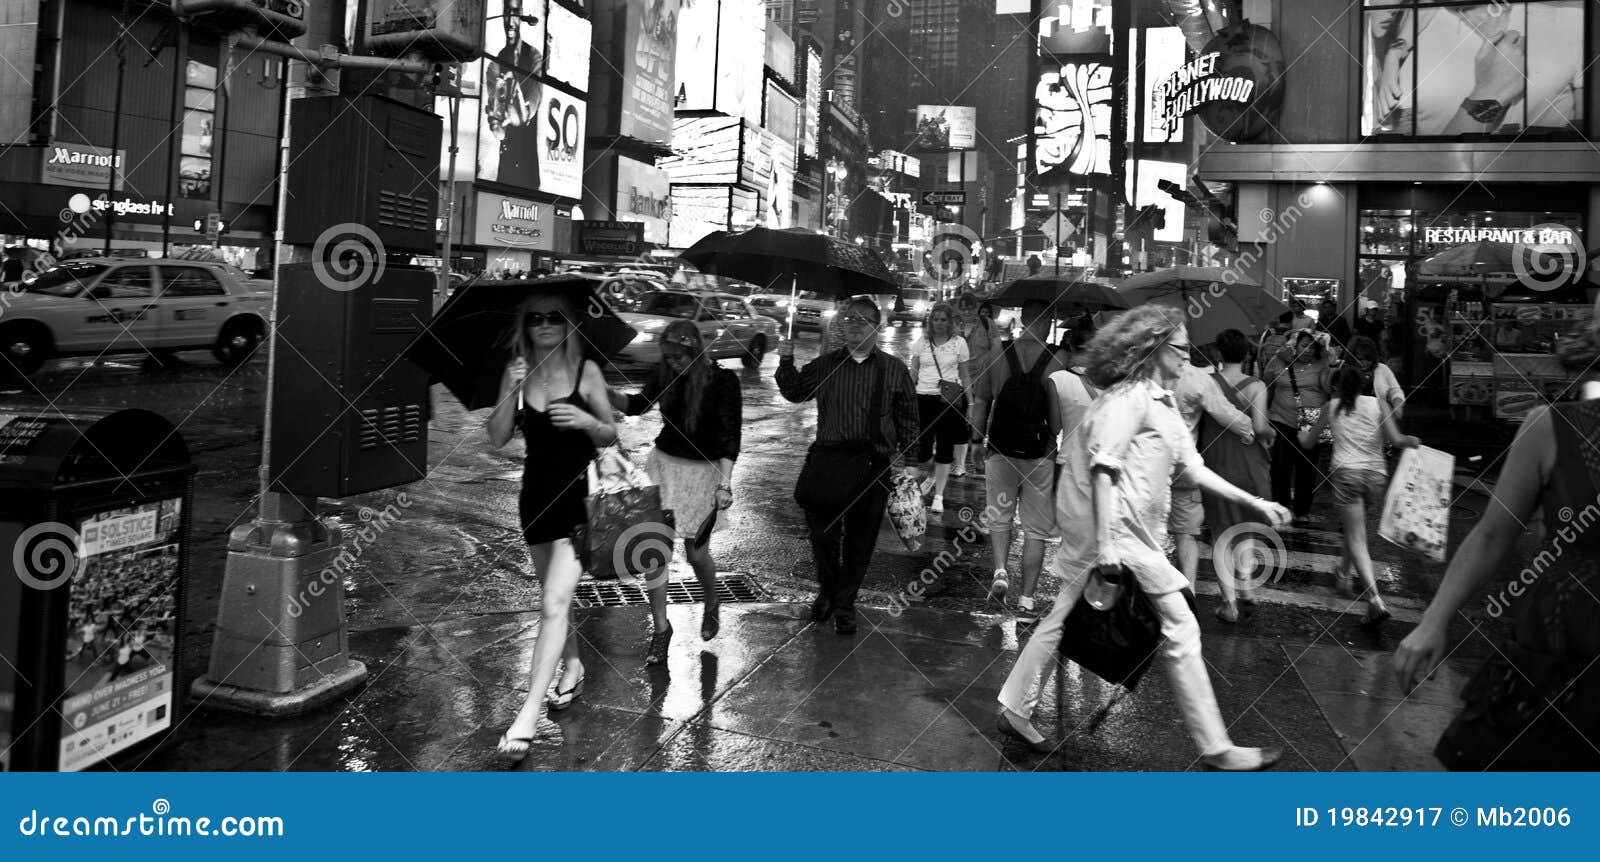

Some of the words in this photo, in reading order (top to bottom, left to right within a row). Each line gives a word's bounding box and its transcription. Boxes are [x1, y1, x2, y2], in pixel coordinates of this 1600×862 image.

[1158, 52, 1221, 116] PLANET
[1162, 76, 1254, 140] HOLLYWOOD
[545, 97, 579, 155] SO
[1424, 228, 1522, 244] RESTAURANT
[1538, 228, 1574, 245] BAR
[100, 514, 154, 540] SOLSTICE
